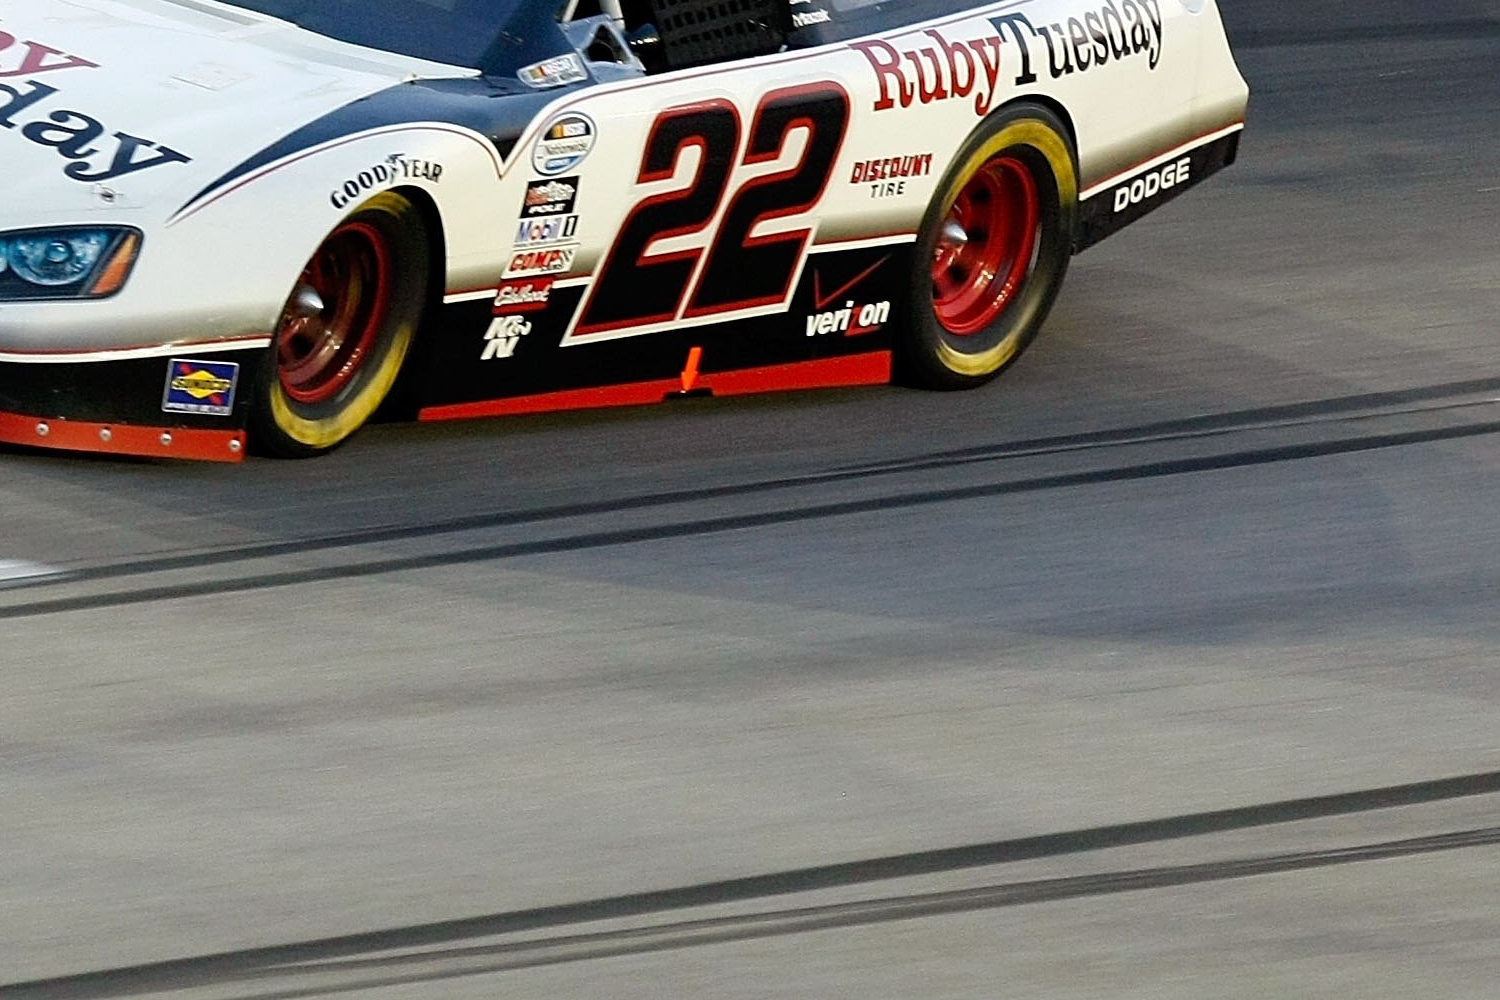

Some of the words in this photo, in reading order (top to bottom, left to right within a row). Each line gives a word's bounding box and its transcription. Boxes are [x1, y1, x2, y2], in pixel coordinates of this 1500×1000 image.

[850, 28, 1002, 117] Ruby
[329, 158, 443, 210] GOODYEAR
[850, 152, 934, 185] DISCOUNT
[870, 180, 906, 199] TIRE
[1113, 156, 1191, 214] DODGE
[570, 80, 851, 338] 22
[805, 299, 891, 338] verizon
